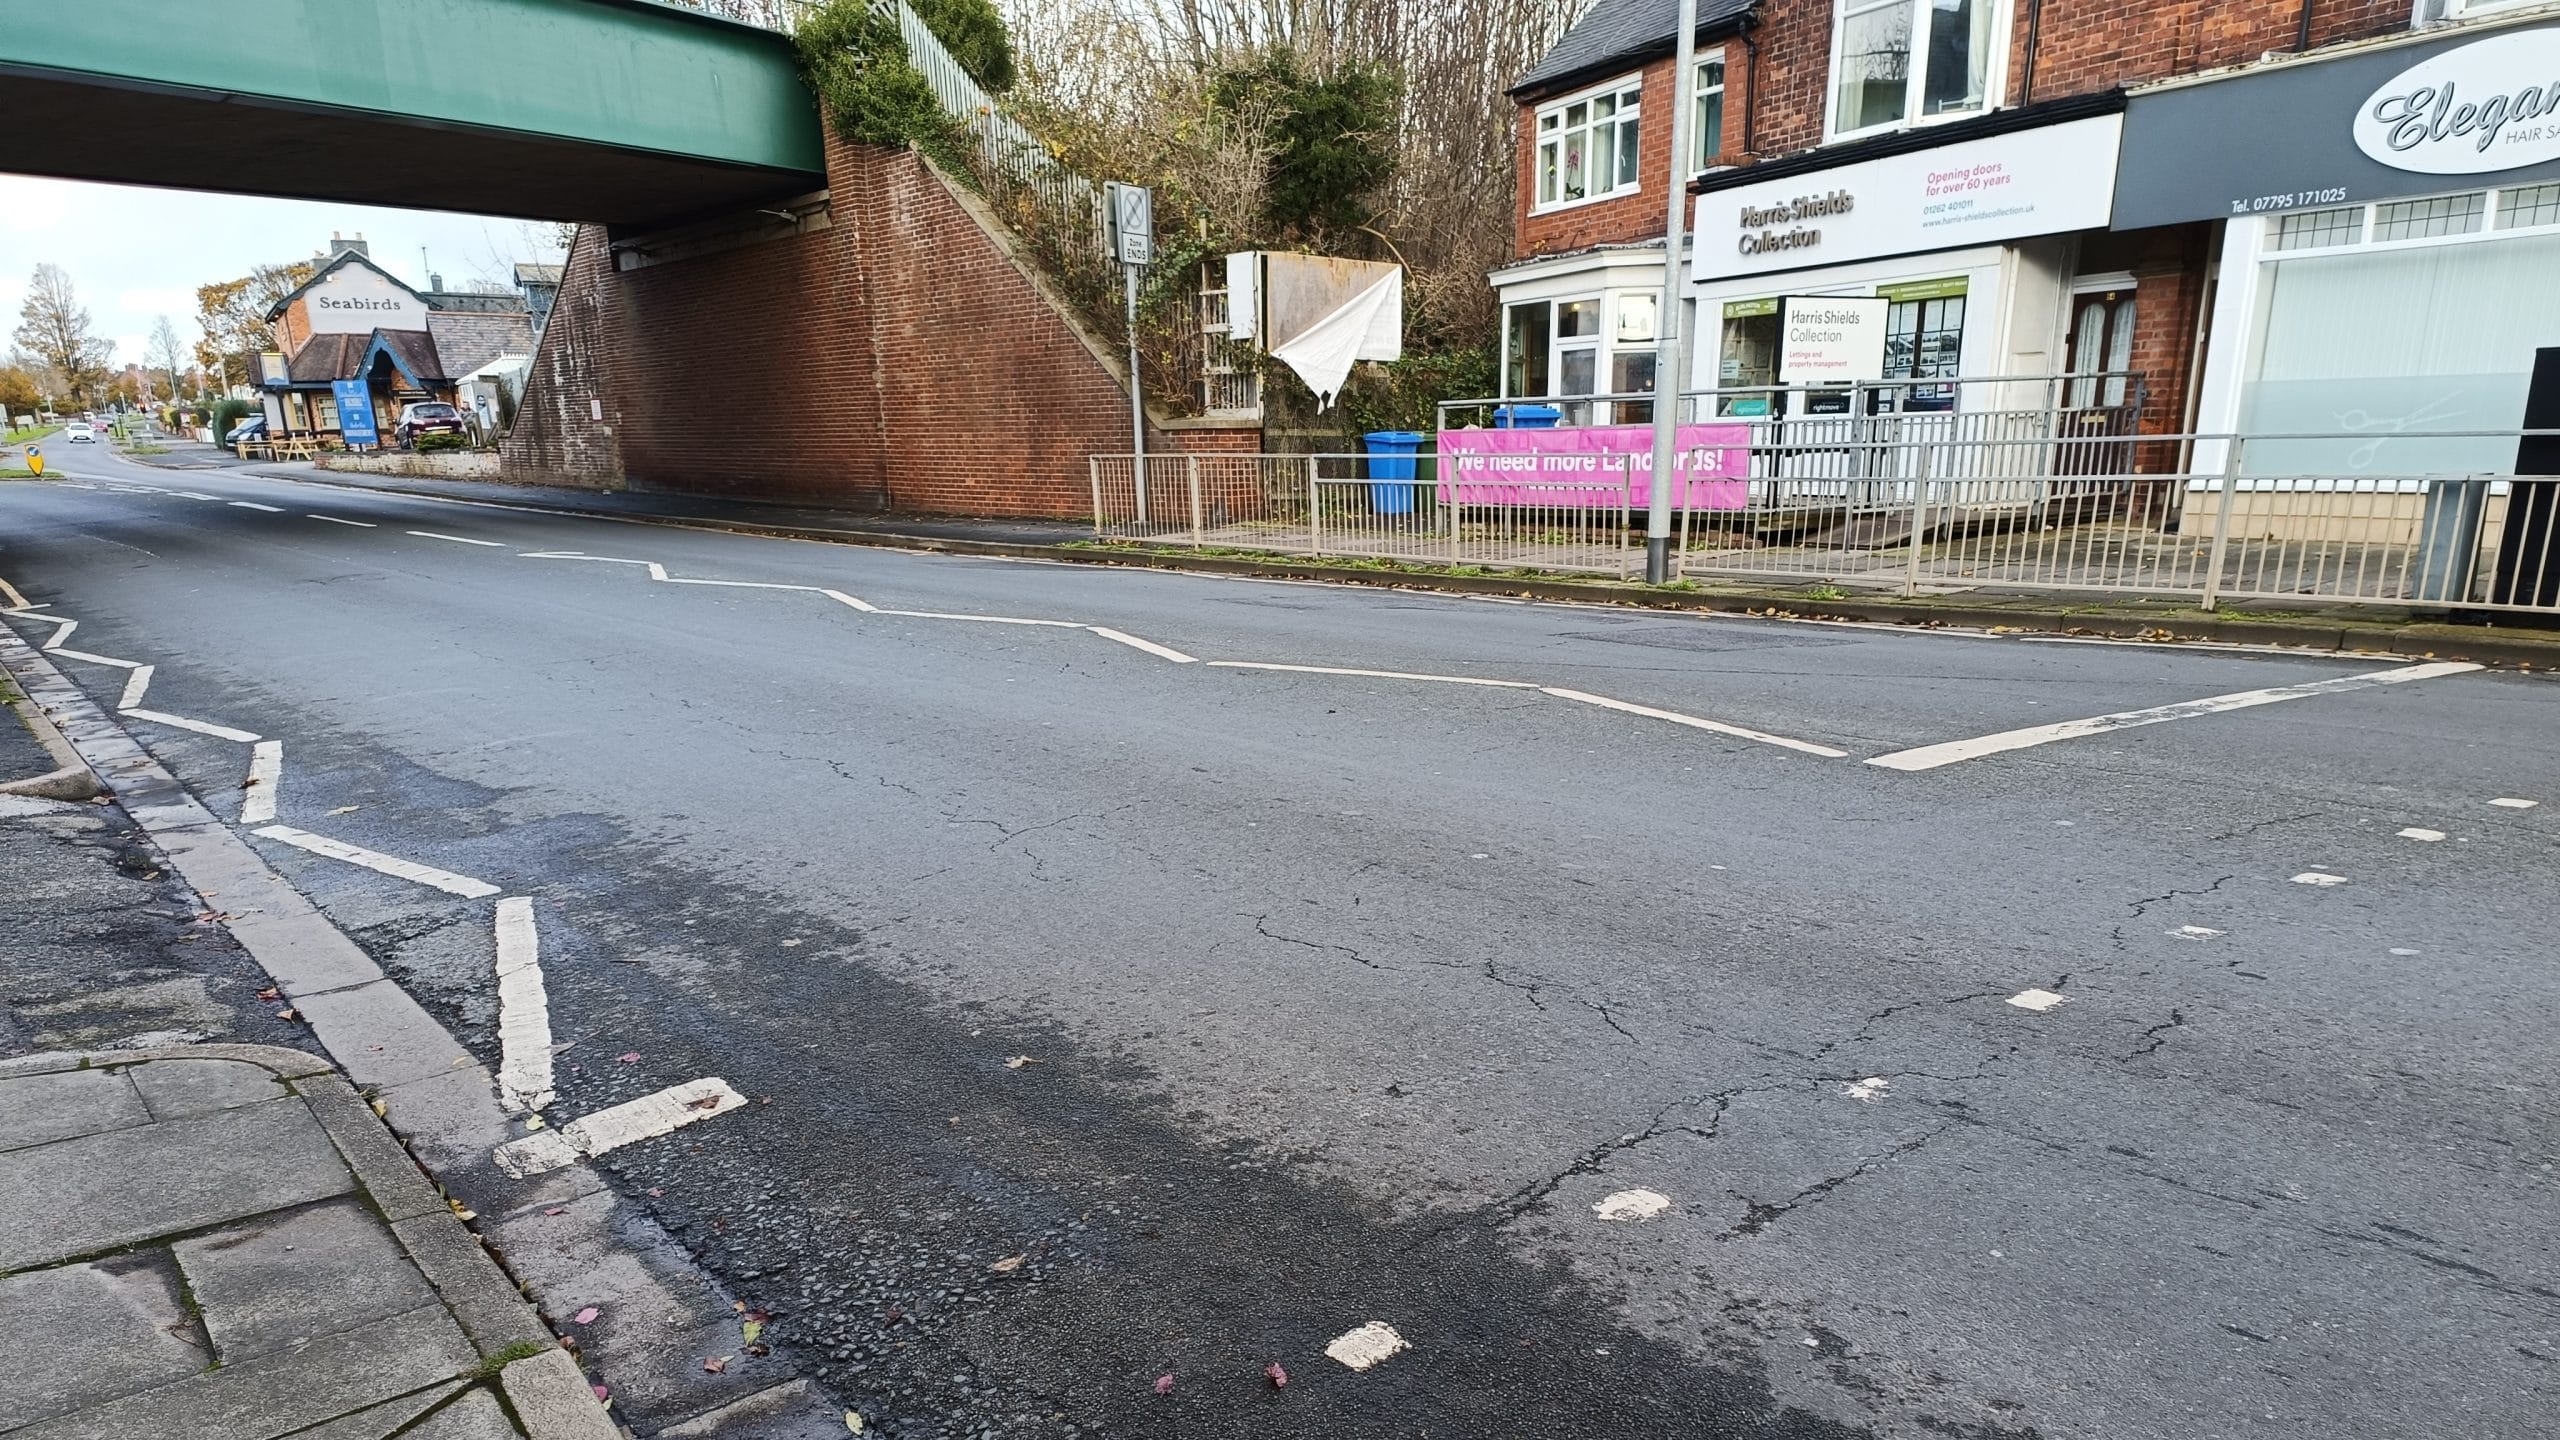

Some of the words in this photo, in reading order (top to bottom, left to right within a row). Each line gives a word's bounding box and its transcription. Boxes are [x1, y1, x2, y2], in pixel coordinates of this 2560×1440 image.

[2506, 127, 2542, 145] HAIR
[1927, 168, 1970, 185] Opening
[1972, 163, 2002, 177] doors
[1926, 185, 1940, 197] for
[1942, 181, 1965, 195] over
[1967, 178, 1981, 190] 60
[1983, 174, 2011, 189] years
[1923, 204, 1946, 216] 01262
[1947, 199, 1973, 211] 401011
[2231, 198, 2250, 213] Tel.
[2253, 193, 2294, 211] 07795
[2297, 186, 2347, 206] 171025
[1740, 200, 1790, 229] Harris
[1790, 189, 1855, 221] Shields
[1922, 204, 2036, 229] www.harris-shieldscollection.uk
[1129, 237, 1142, 247] Zone
[1738, 225, 1822, 255] Collection
[1127, 248, 1146, 260] ENDS
[319, 296, 401, 311] Seabirds
[1791, 309, 1823, 325] Harris
[1823, 309, 1861, 325] Shields
[1790, 327, 1842, 343] Collection
[1789, 351, 1811, 360] Lettings
[1788, 361, 1812, 369] property
[1813, 360, 1848, 369] management
[1453, 447, 1484, 471] We
[1489, 446, 1538, 472] need
[1543, 456, 1597, 472] more
[1602, 443, 1724, 472] Landrds!
